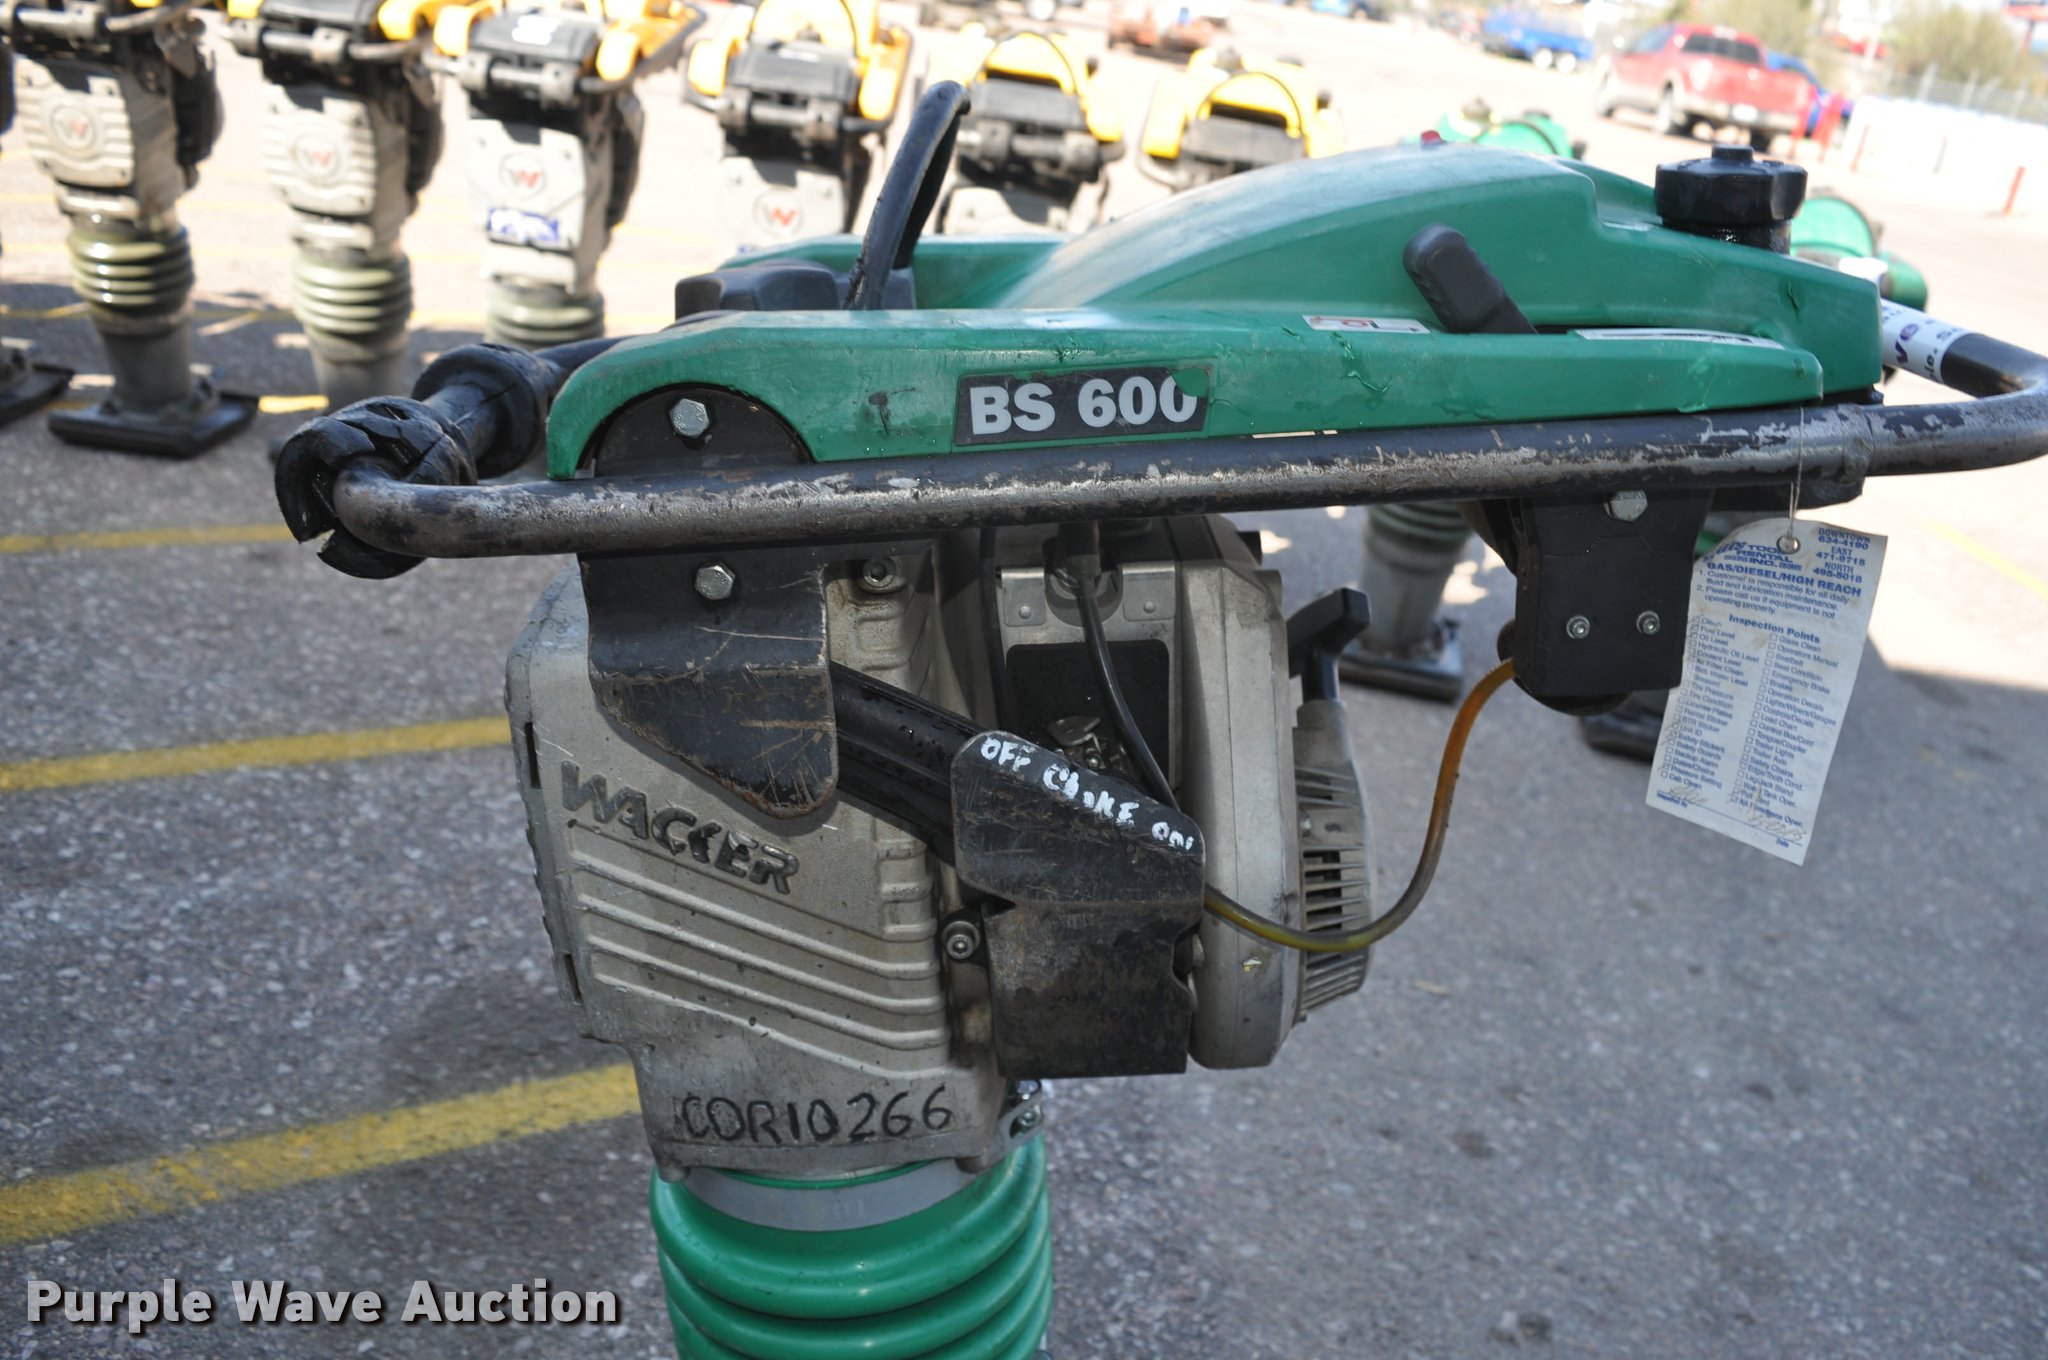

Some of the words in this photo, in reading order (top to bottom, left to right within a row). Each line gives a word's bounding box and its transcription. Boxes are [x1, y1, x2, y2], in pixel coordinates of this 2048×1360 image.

[969, 382, 1056, 435] BS
[1077, 375, 1198, 429] 600
[1818, 527, 1870, 544] DOWNTOWN
[1736, 550, 1793, 563] RENTAL
[1831, 546, 1852, 556] EAST
[1749, 558, 1778, 567] INC.
[1824, 562, 1854, 573] NORTH
[1707, 562, 1814, 587] GAS/DIESEL/HIGH
[1817, 580, 1861, 597] REACH
[1707, 570, 1747, 582] Customer
[1748, 576, 1756, 584] is
[1757, 579, 1803, 593] responsible
[1805, 587, 1816, 596] for
[1829, 593, 1849, 605] daily
[1707, 578, 1724, 586] fluid
[1725, 581, 1740, 590] and
[1742, 584, 1783, 598] lubrication
[1705, 594, 1741, 607] operating
[1706, 585, 1733, 595] Please
[1734, 591, 1748, 599] call
[1769, 598, 1811, 613] equipment
[1821, 610, 1835, 619] not
[1700, 625, 1715, 634] Fuel
[1717, 629, 1735, 639] Level
[1729, 614, 1784, 633] Inspection
[1787, 627, 1820, 643] Points
[1710, 637, 1728, 646] Level
[1779, 635, 1799, 646] Glass
[1800, 641, 1821, 652] Clean
[1698, 641, 1729, 655] Hydraulic
[1730, 649, 1740, 658] Oil
[1741, 653, 1759, 663] Level
[1777, 644, 1811, 659] Operators
[1812, 654, 1839, 668] Manual
[1724, 657, 1741, 666] Level
[1724, 666, 1743, 677] Clean
[1774, 661, 1790, 671] Seat
[1791, 667, 1823, 682] Condition
[1731, 676, 1748, 687] Level
[1769, 679, 1793, 691] Brakes
[1772, 670, 1809, 688] Emergency
[1810, 682, 1831, 695] Brake
[1704, 686, 1734, 700] Pressure
[1767, 687, 1800, 703] Operation
[1801, 698, 1824, 712] Decals
[1702, 695, 1733, 710] Condition
[1712, 707, 1733, 719] Plates
[1759, 722, 1782, 736] Control
[1760, 714, 1778, 724] Load
[1778, 719, 1797, 731] Chart
[981, 736, 1035, 772] OFF
[1775, 746, 1795, 759] Lights
[1771, 764, 1794, 778] Chains
[1683, 778, 1702, 789] Clean
[561, 759, 799, 895] WACKER
